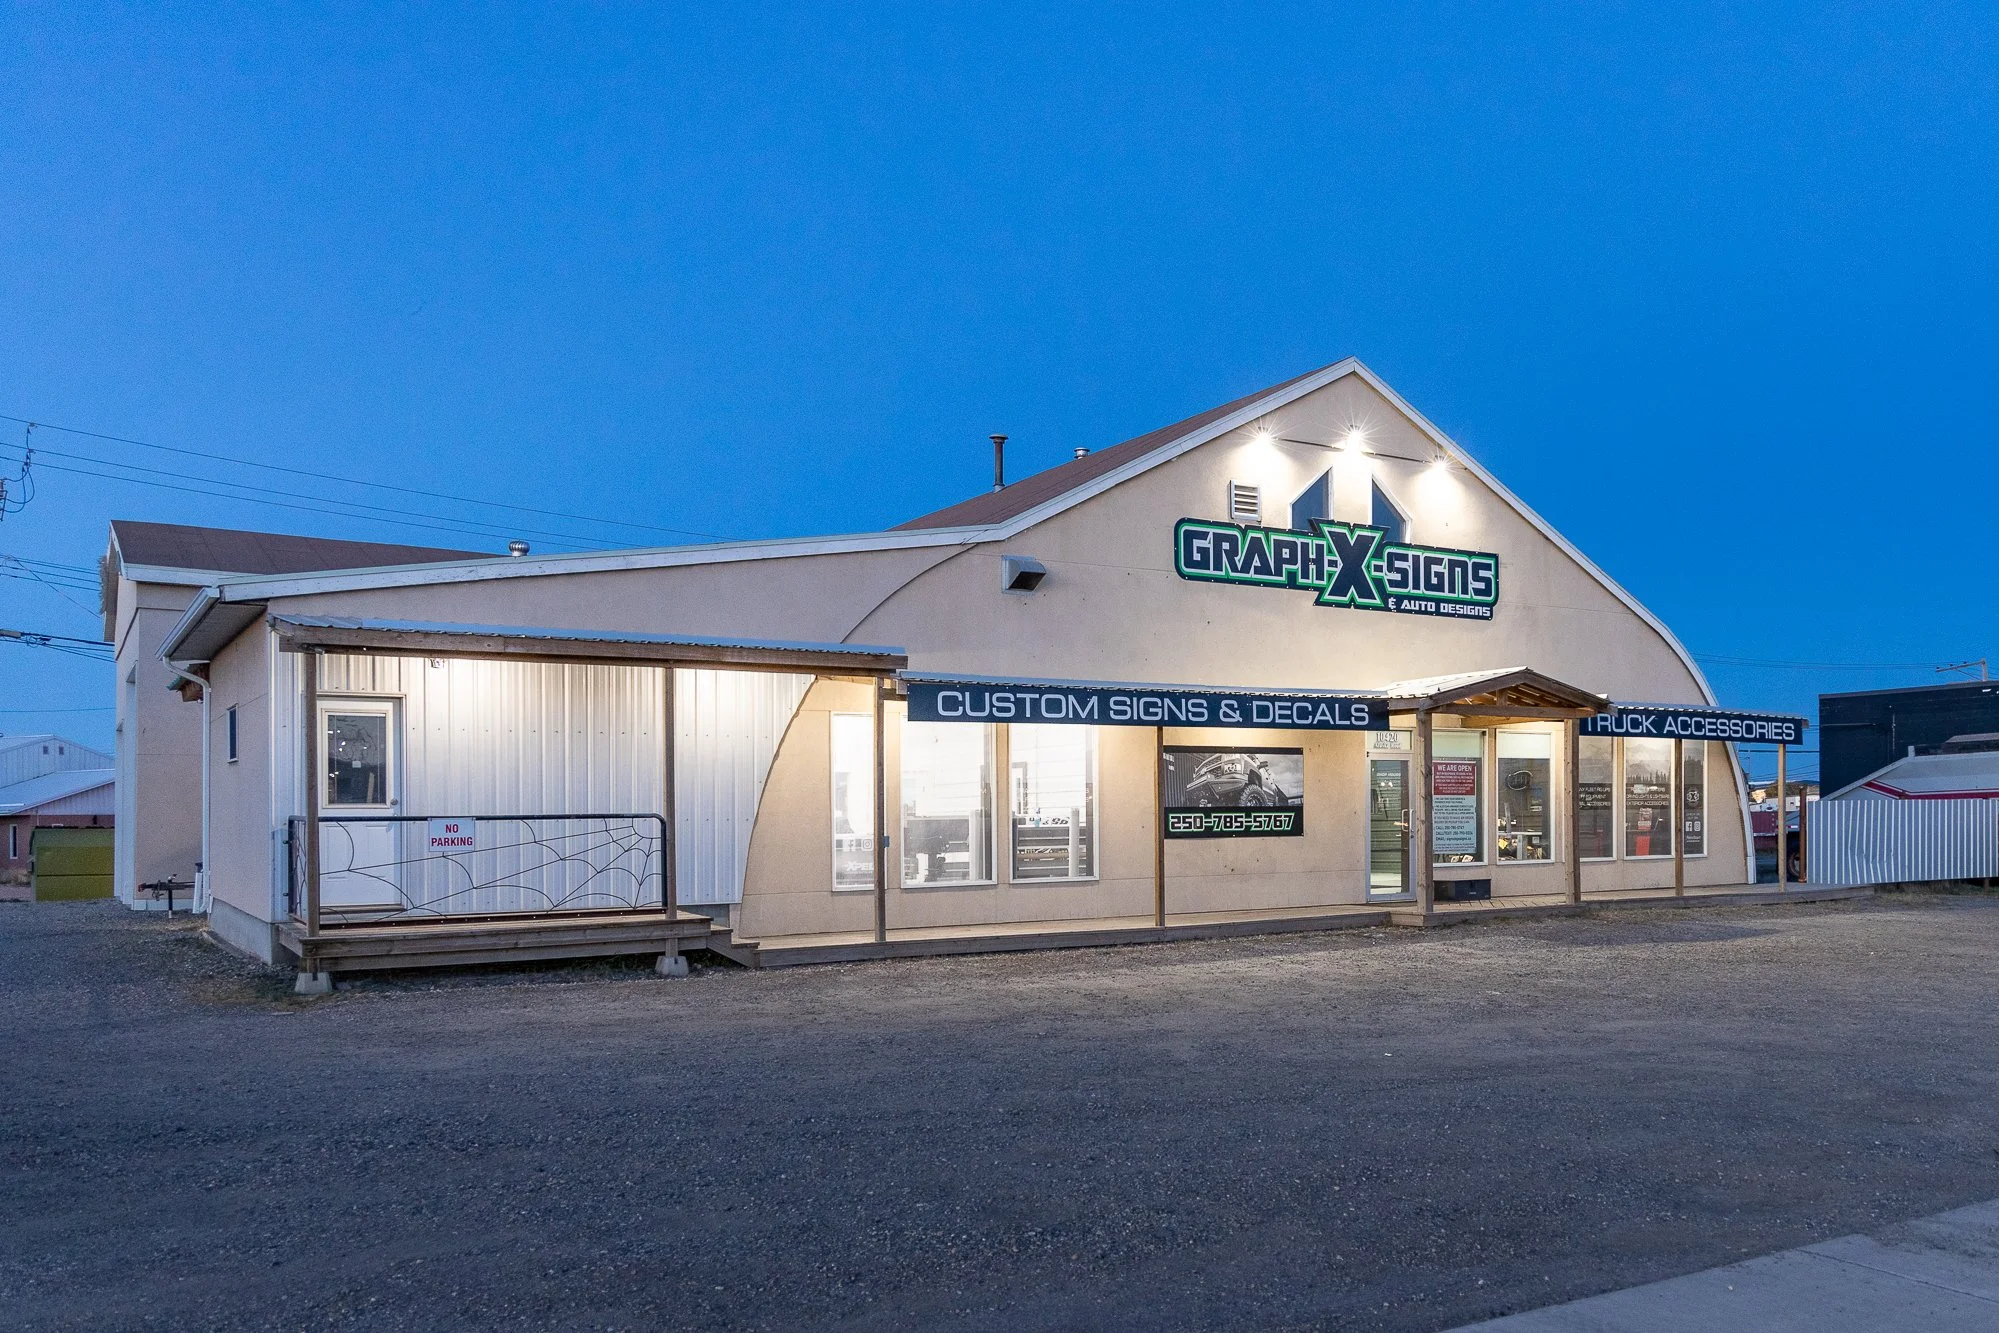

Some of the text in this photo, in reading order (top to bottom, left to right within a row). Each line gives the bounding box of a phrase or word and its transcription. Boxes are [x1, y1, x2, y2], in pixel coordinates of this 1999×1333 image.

[1400, 599, 1435, 612] AUTO
[1440, 602, 1491, 617] DESIGNS
[937, 691, 1369, 726] CUSTOM SIGNS & DECALS
[1375, 732, 1399, 743] 10420
[1663, 715, 1795, 741] ACCESSORIES
[1446, 764, 1457, 772] ARE
[1169, 813, 1295, 832] 250-785-5767
[431, 823, 473, 847] NO PARKING
